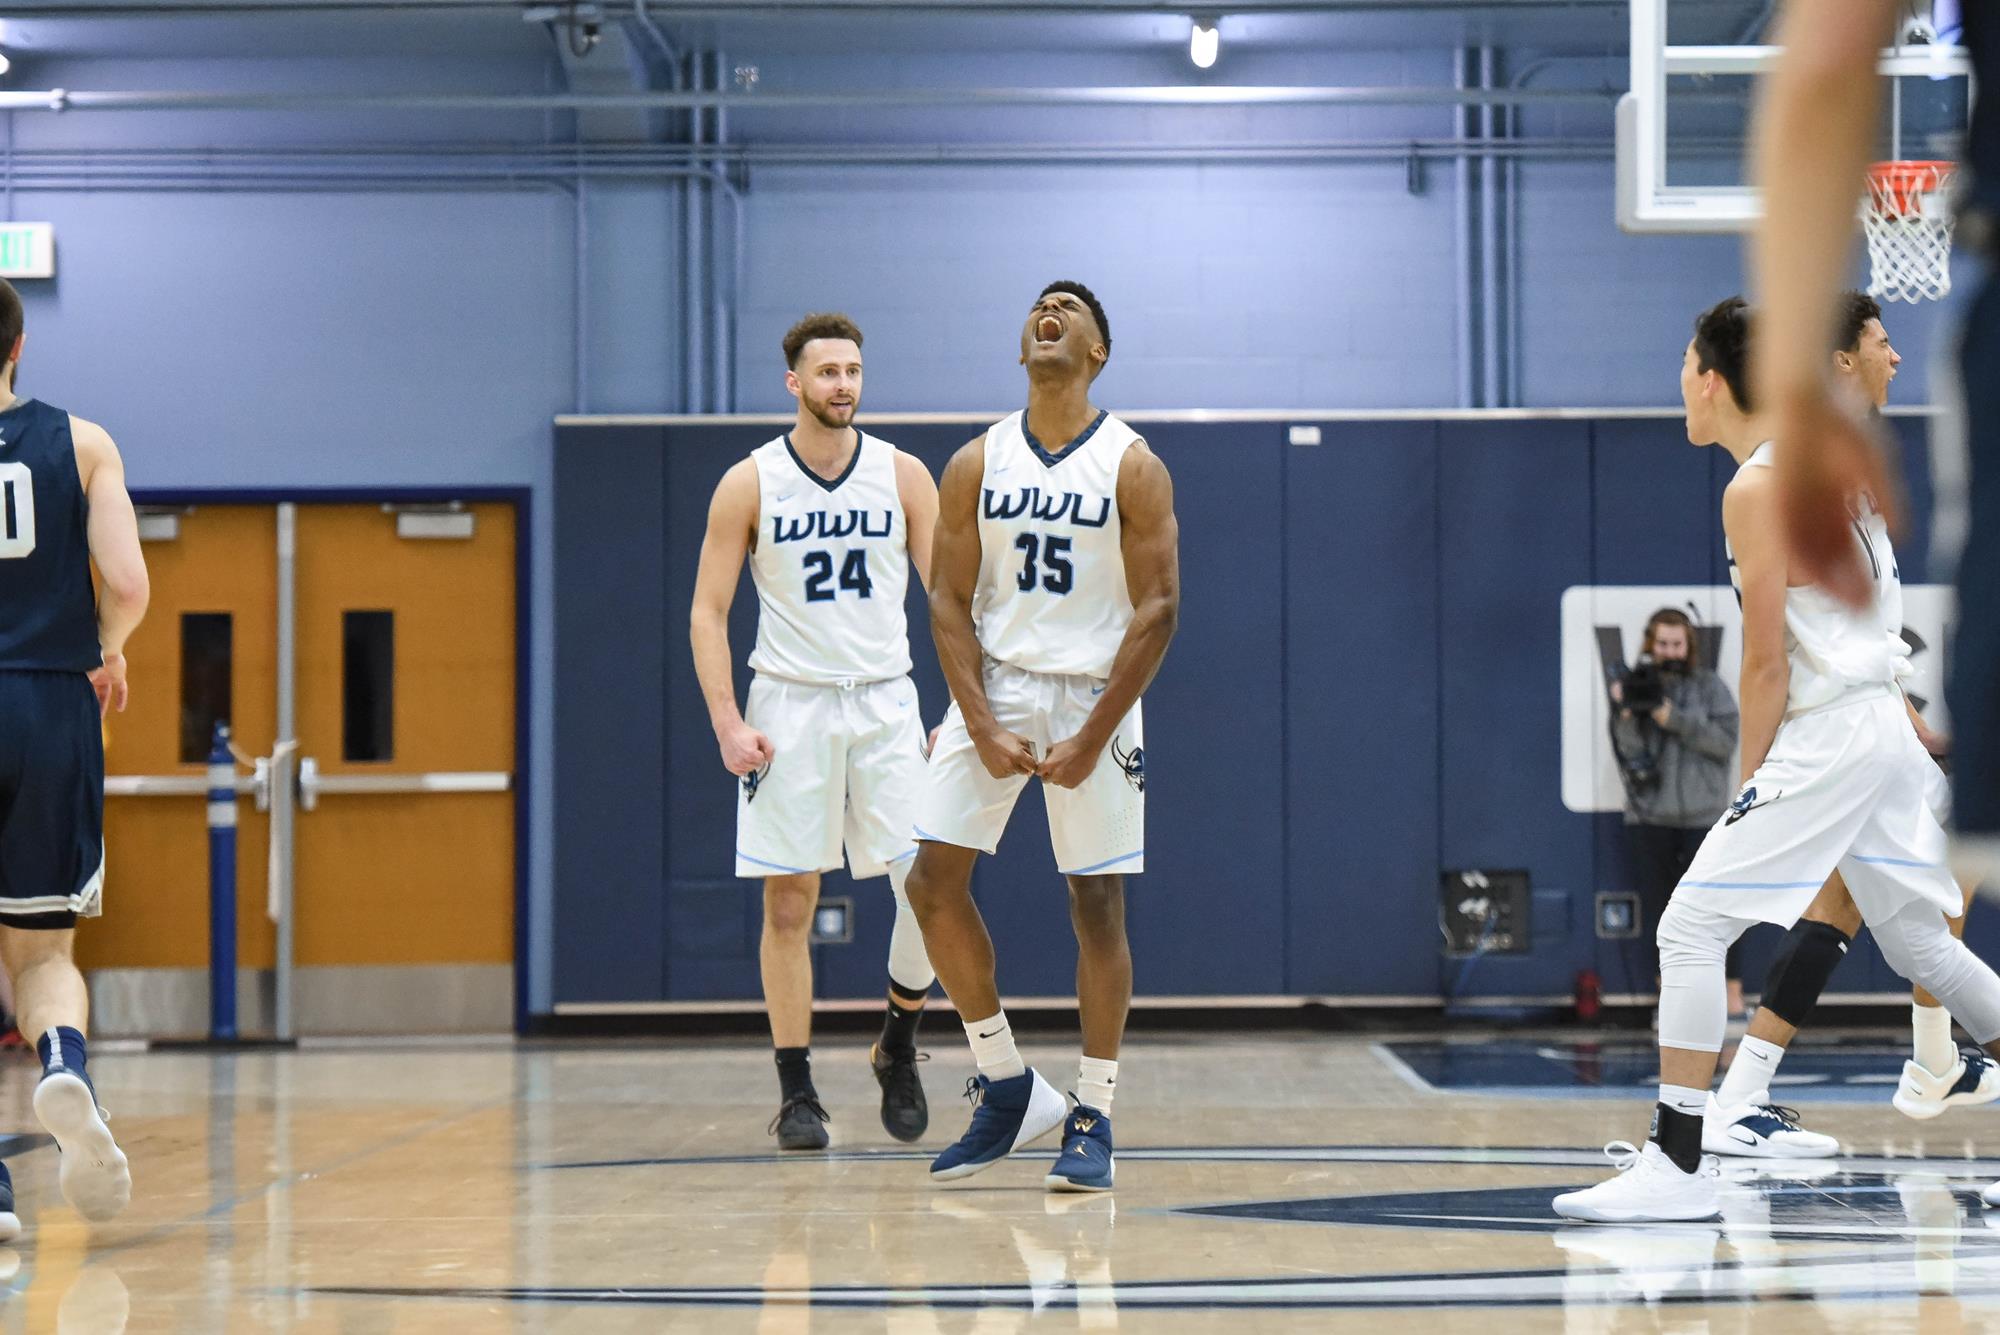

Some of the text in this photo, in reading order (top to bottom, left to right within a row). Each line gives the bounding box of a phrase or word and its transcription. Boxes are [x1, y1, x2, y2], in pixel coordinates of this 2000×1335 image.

[772, 510, 892, 543] WWU
[983, 487, 1111, 528] WWU
[803, 549, 873, 603] 24
[1015, 531, 1073, 596] 35
